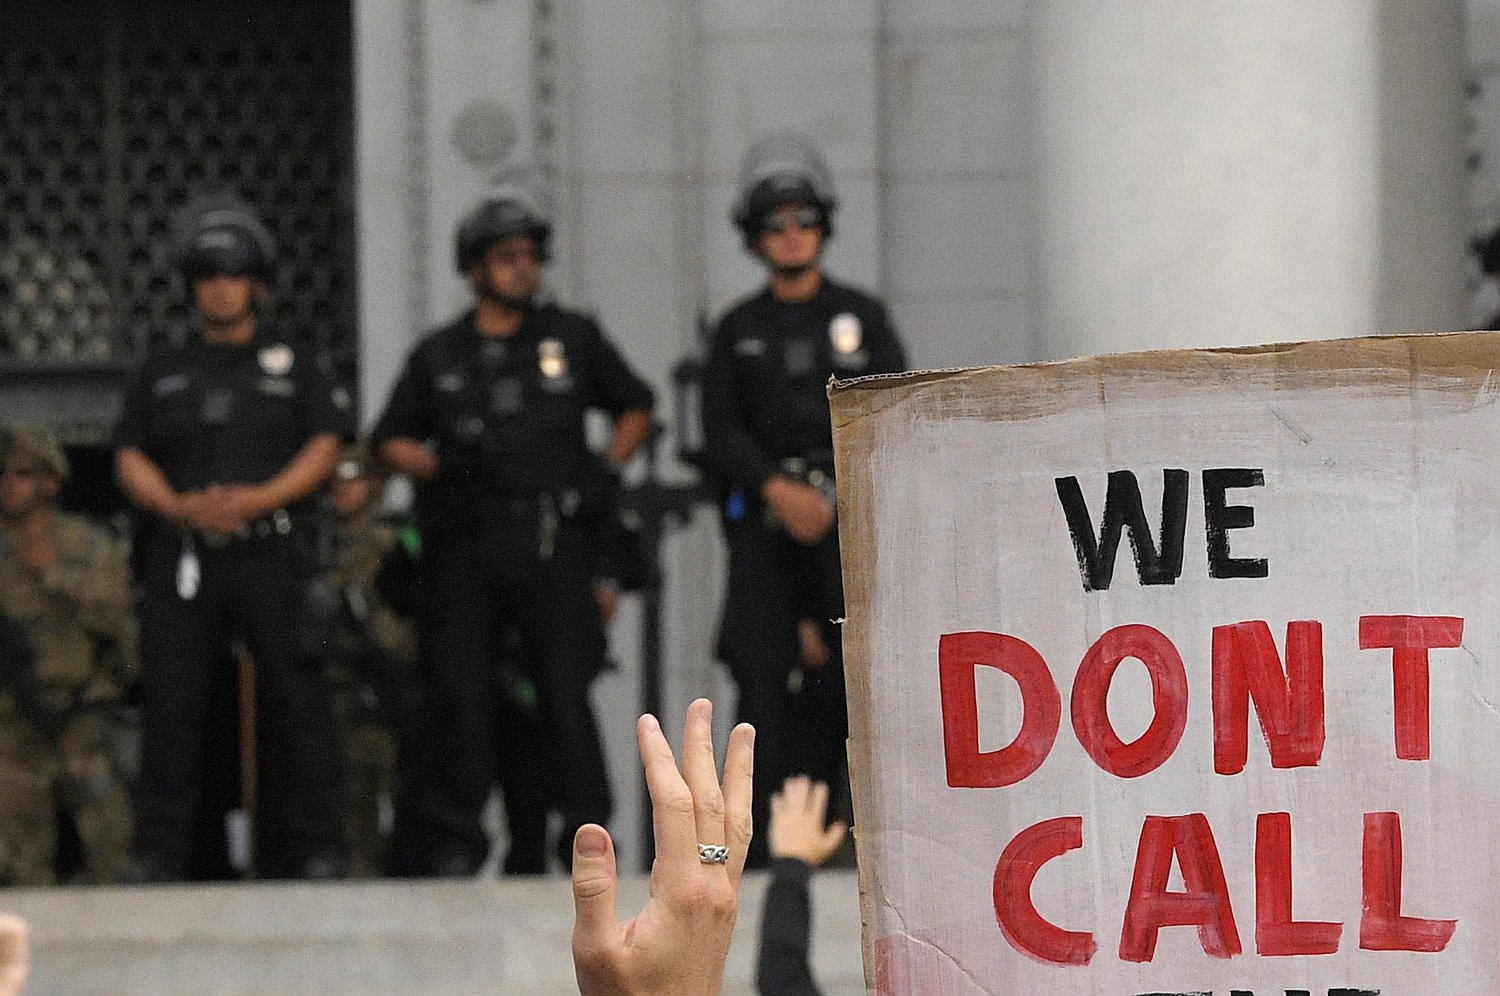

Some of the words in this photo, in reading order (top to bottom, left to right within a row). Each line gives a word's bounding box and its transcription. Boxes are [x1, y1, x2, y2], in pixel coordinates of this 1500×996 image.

[1055, 468, 1269, 592] WE
[938, 615, 1464, 788] DONT
[992, 811, 1459, 966] CALL
